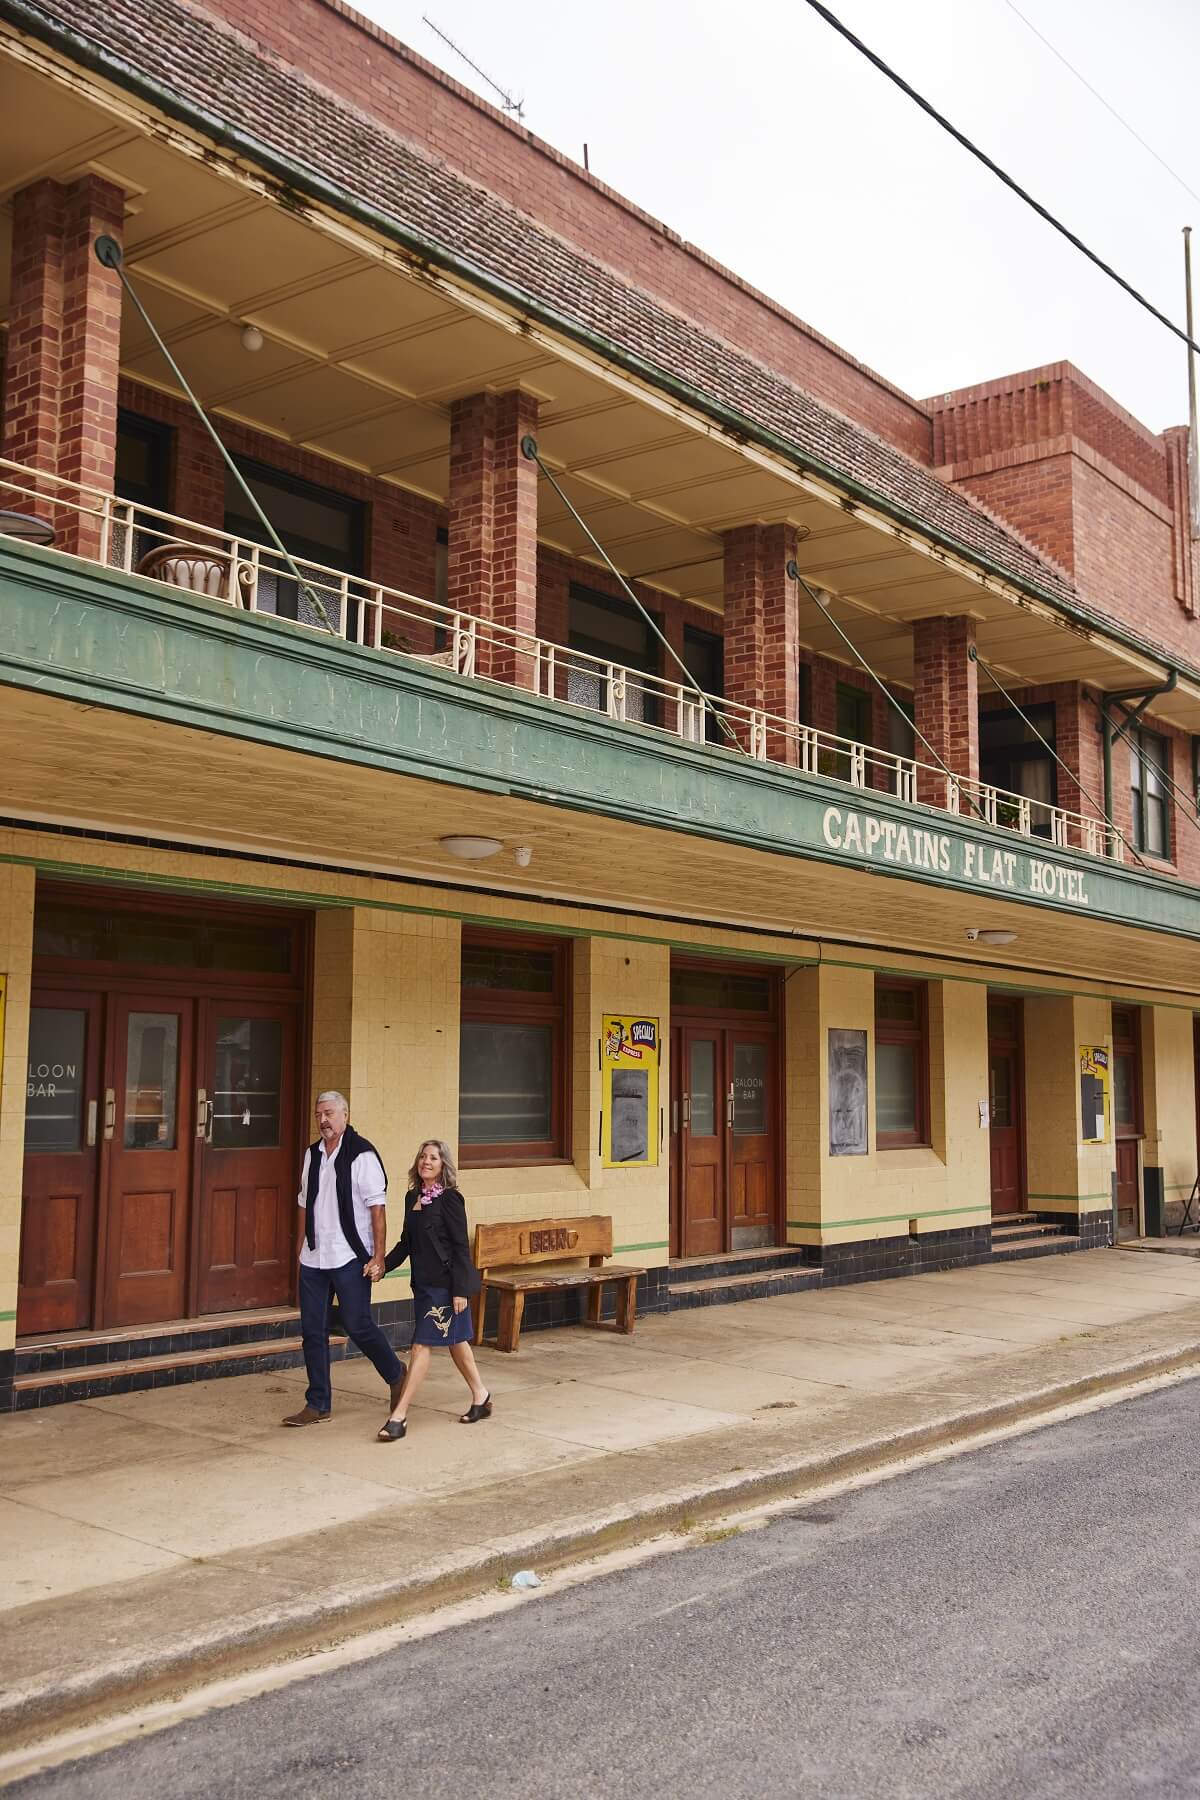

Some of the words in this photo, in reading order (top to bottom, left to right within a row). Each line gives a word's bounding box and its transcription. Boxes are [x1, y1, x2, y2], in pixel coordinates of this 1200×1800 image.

[823, 807, 951, 872] CAPTAINS
[963, 842, 1017, 886] FLAT
[1029, 858, 1089, 904] HOTEL
[632, 1024, 655, 1041] SPECIALS
[29, 1063, 76, 1078] LOON
[27, 1083, 56, 1097] BAR
[735, 1078, 763, 1088] SALOON
[529, 1228, 567, 1254] BEER
